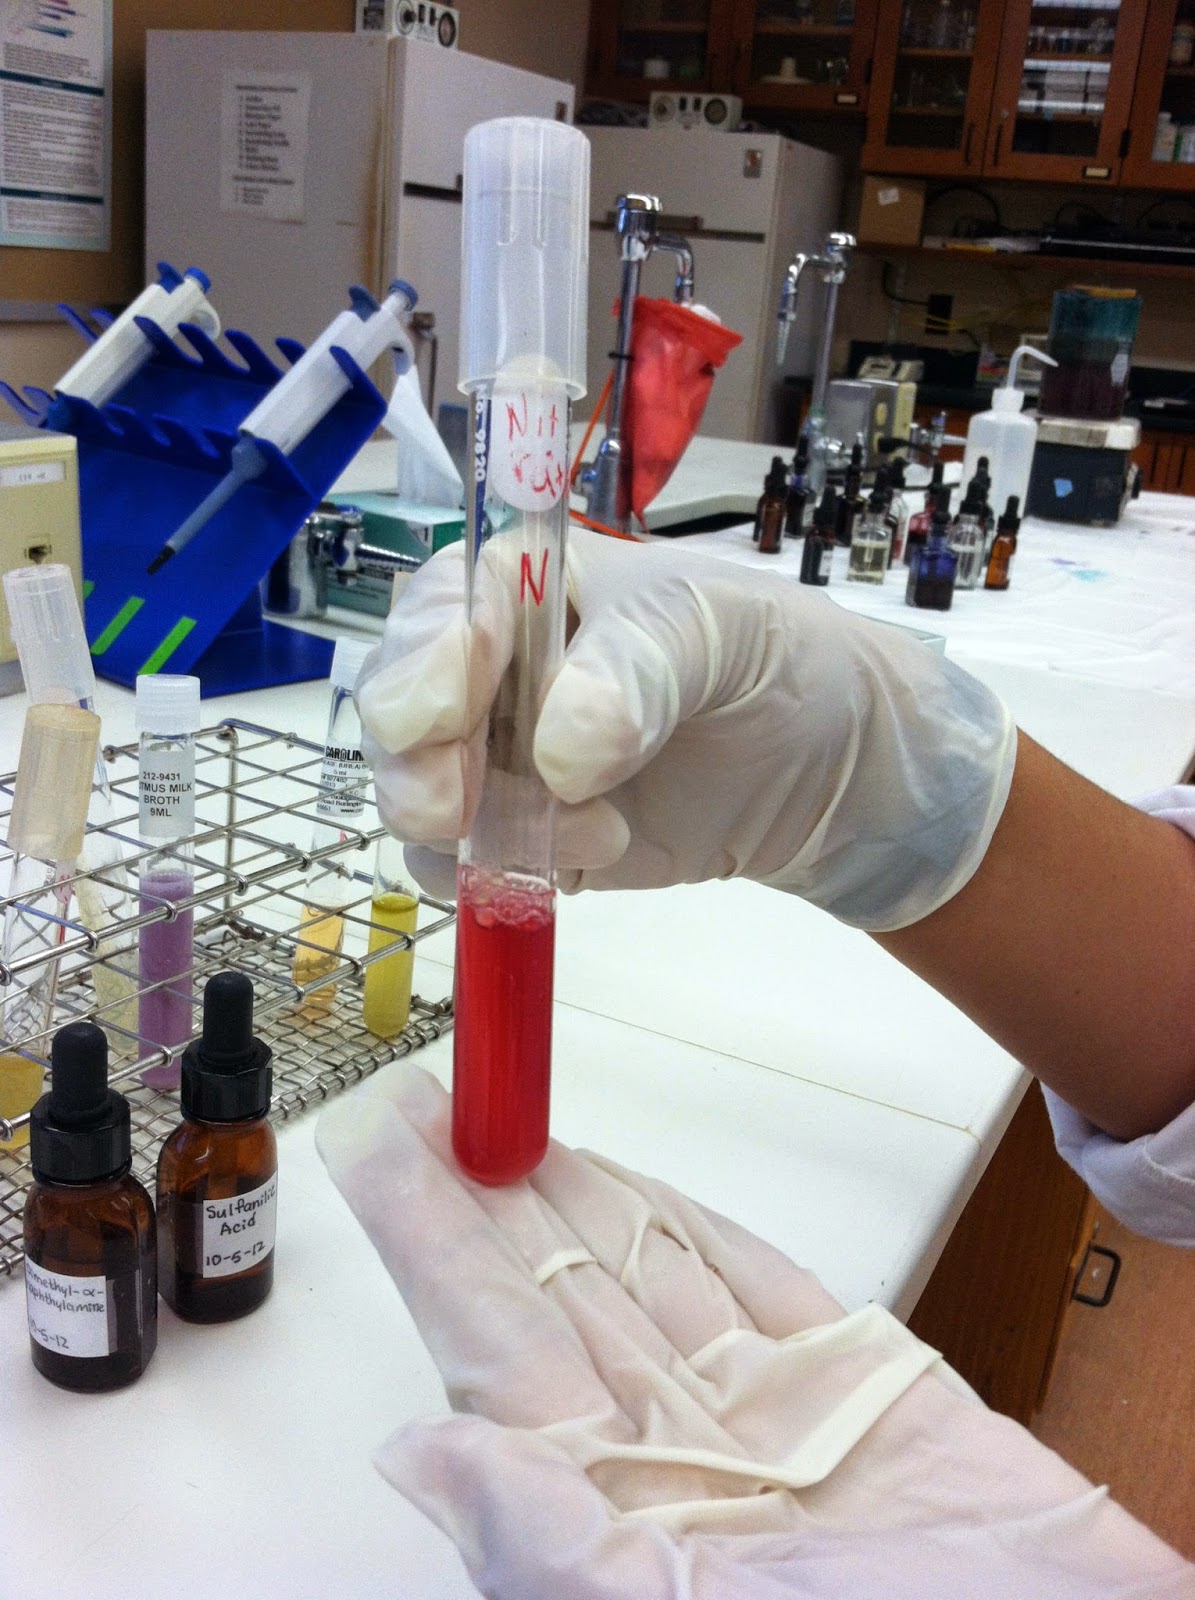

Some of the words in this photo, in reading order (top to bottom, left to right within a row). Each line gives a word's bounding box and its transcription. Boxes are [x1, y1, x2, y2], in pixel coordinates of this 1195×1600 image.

[519, 548, 549, 607] N
[325, 746, 364, 761] CAROLIN
[142, 771, 181, 781] 212-9431
[169, 782, 192, 793] MILK
[143, 794, 180, 805] BROTH
[149, 807, 172, 817] 9ML
[206, 1184, 275, 1219] Sulfanilic
[220, 1211, 256, 1236] Acid
[206, 1241, 265, 1266] 10-5-12
